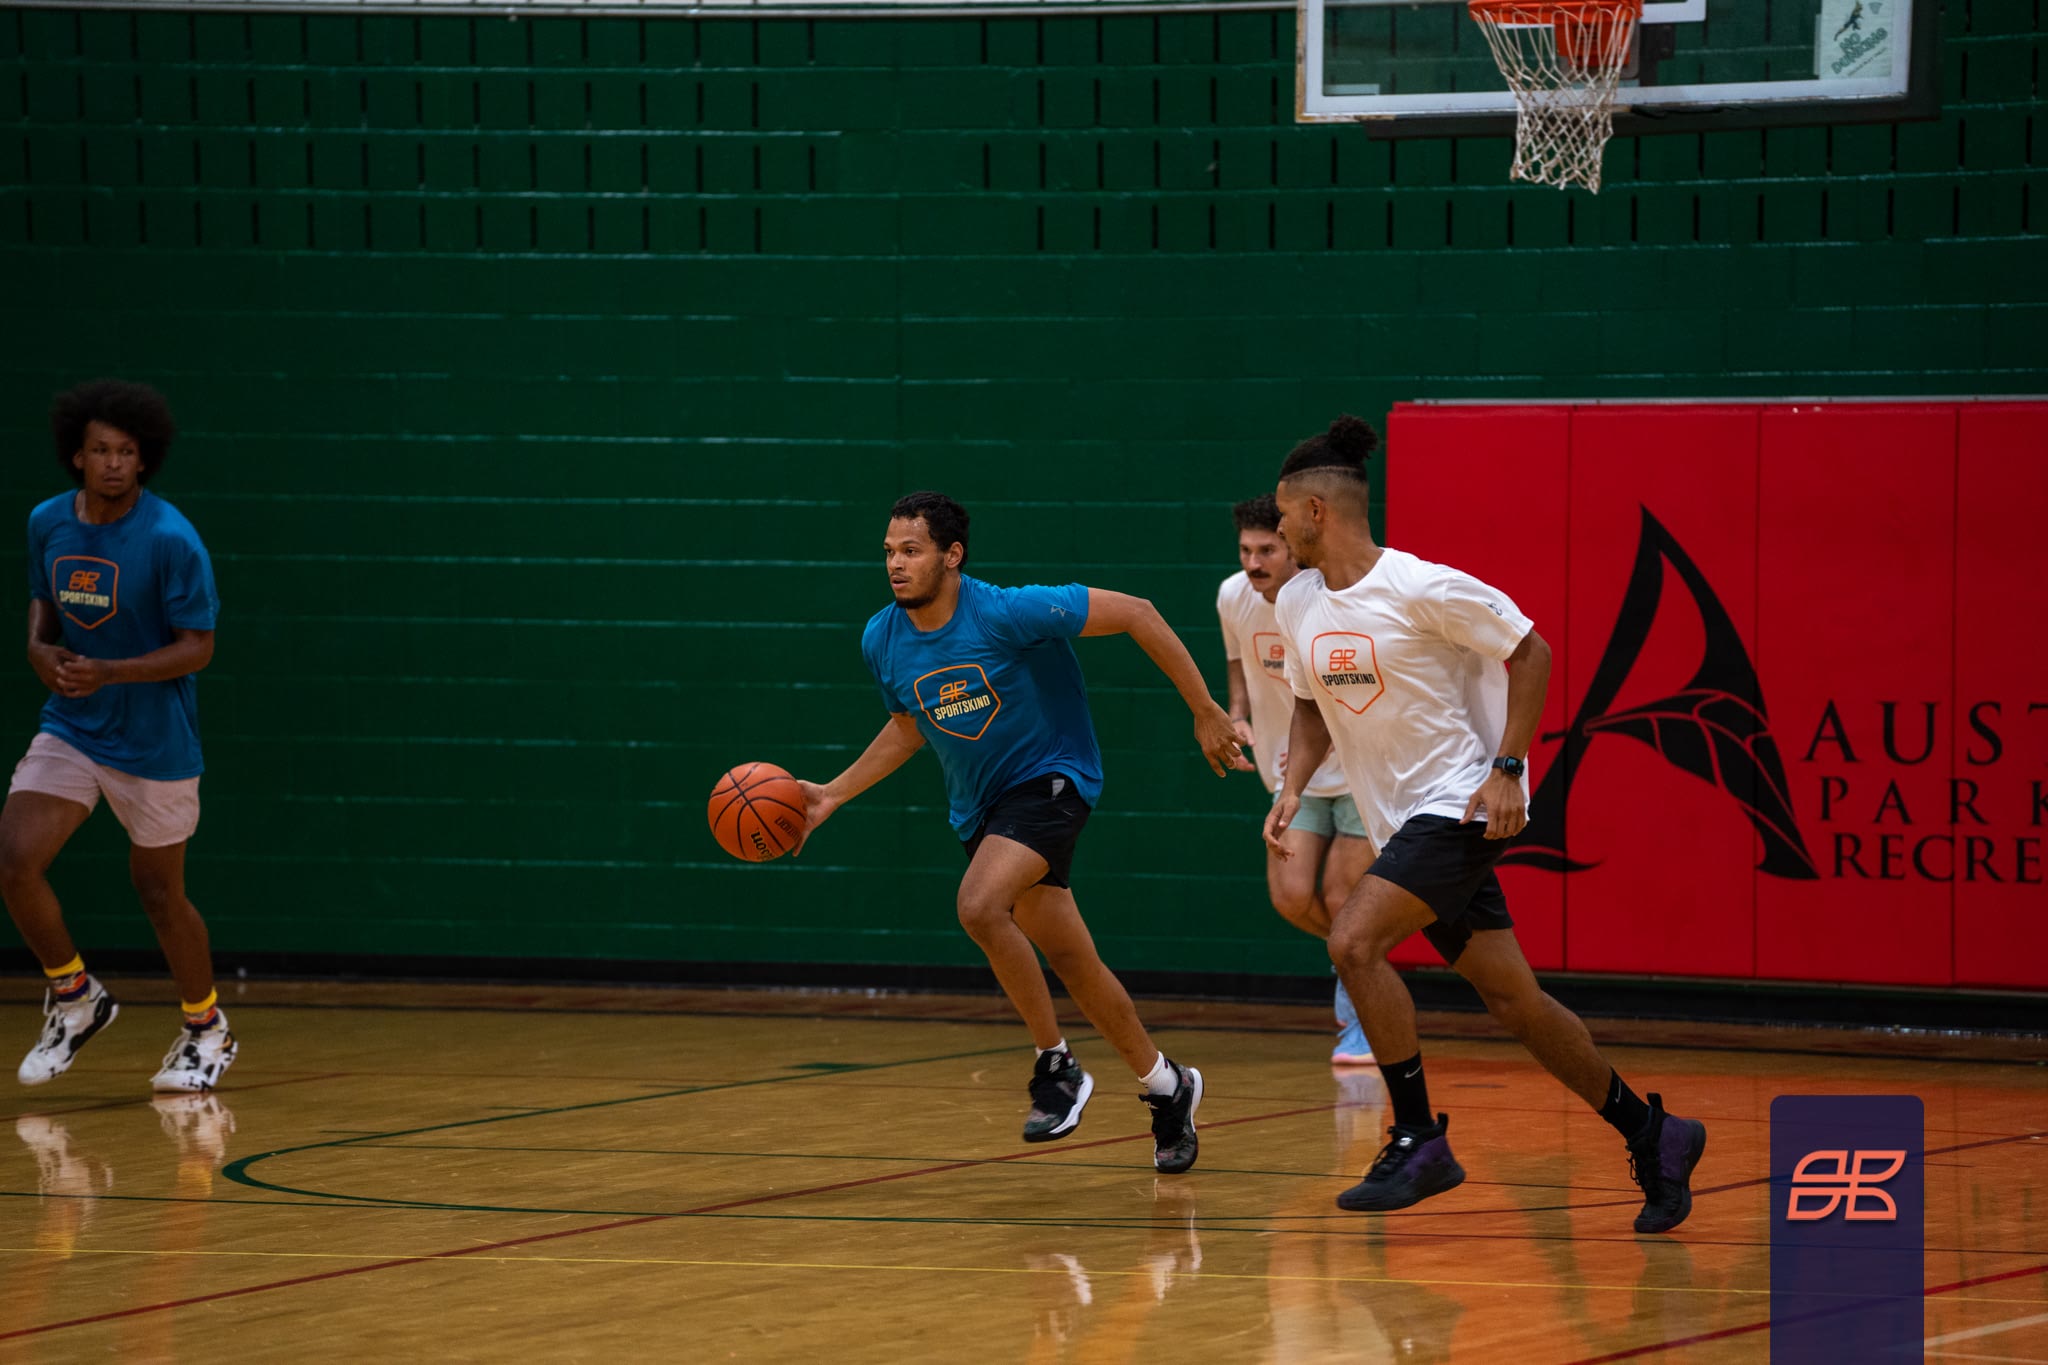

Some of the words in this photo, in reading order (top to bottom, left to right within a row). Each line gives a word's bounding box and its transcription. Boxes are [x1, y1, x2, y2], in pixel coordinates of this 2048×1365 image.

[59, 590, 109, 608] SPORTSKIND
[1322, 673, 1376, 686] SPORTSKIND
[934, 694, 991, 720] SPORTSKIND
